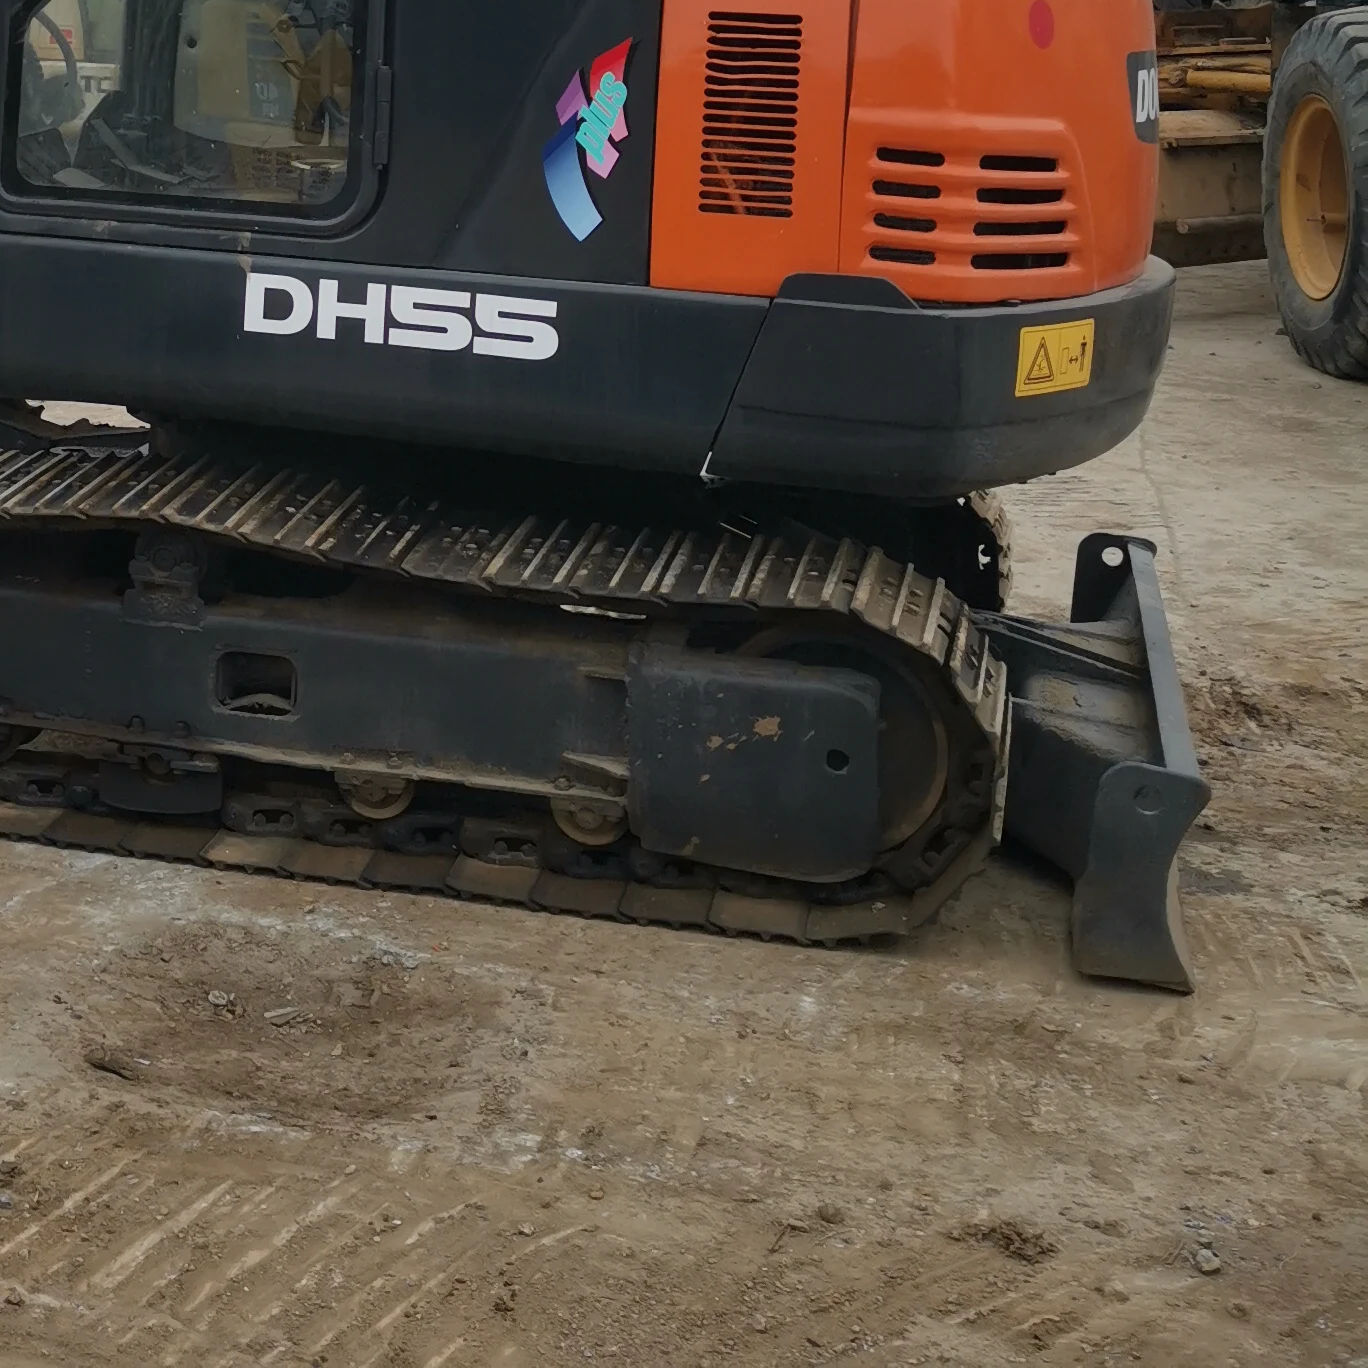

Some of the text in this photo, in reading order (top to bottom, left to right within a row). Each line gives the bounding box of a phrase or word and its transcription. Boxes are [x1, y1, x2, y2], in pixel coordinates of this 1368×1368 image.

[575, 71, 628, 166] plus
[1135, 67, 1159, 123] DO
[243, 272, 559, 361] DH55
